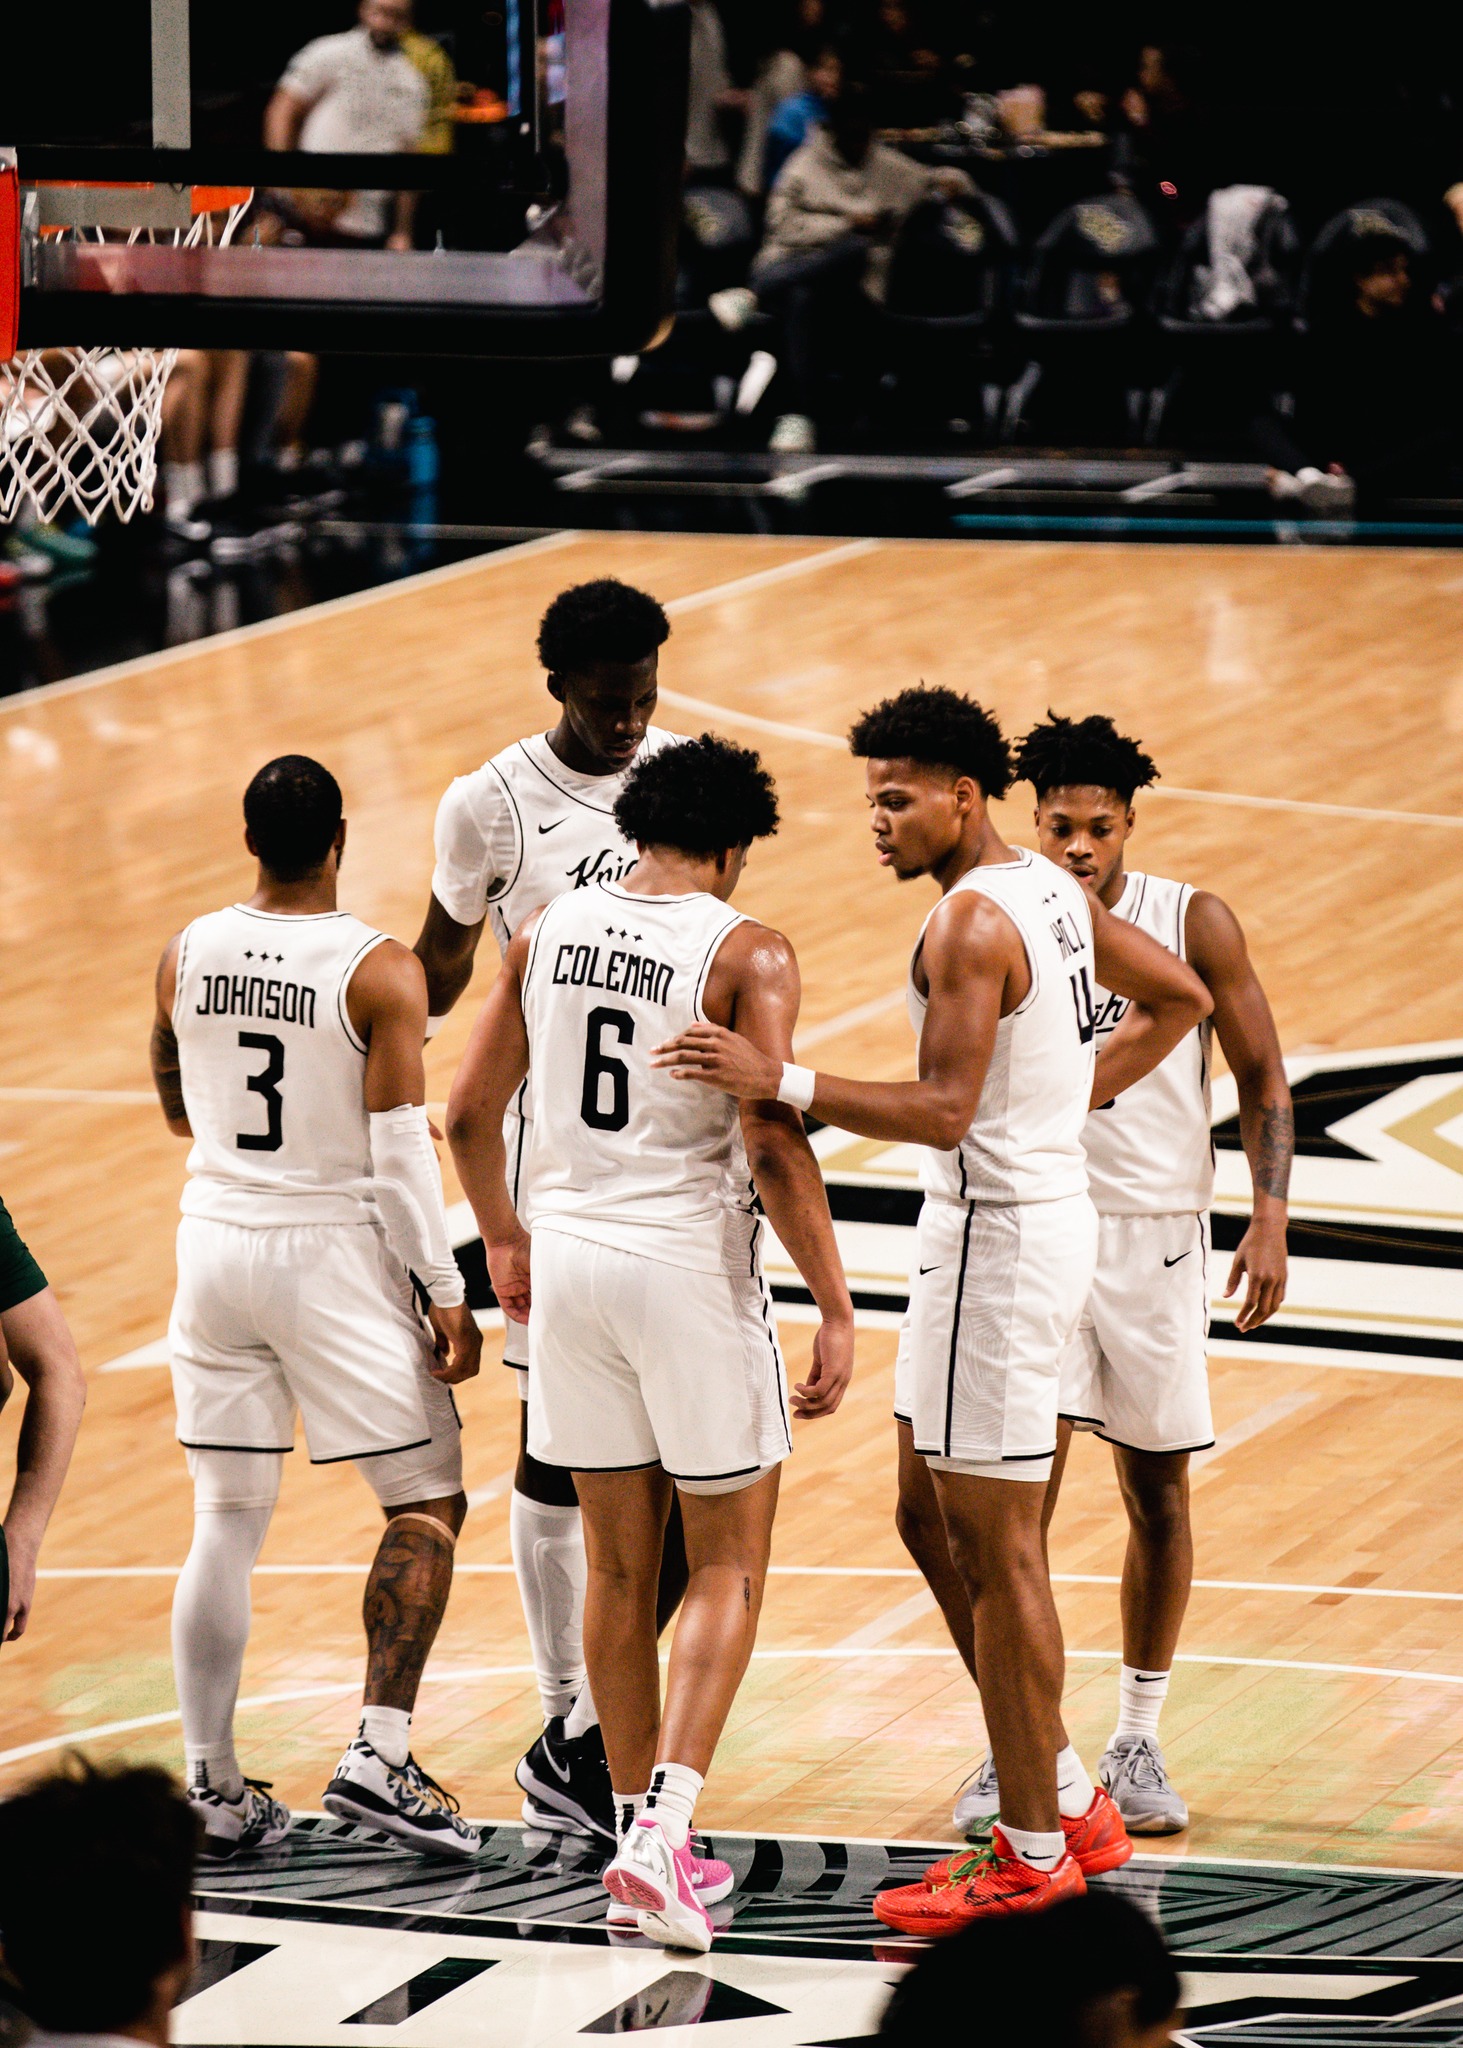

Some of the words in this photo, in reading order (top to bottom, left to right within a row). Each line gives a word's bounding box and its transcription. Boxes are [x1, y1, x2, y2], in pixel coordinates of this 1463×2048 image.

[196, 975, 316, 1029] JOHNSON
[552, 944, 675, 1007] COLEMAN
[236, 1031, 285, 1152] 3
[580, 1006, 635, 1132] 6
